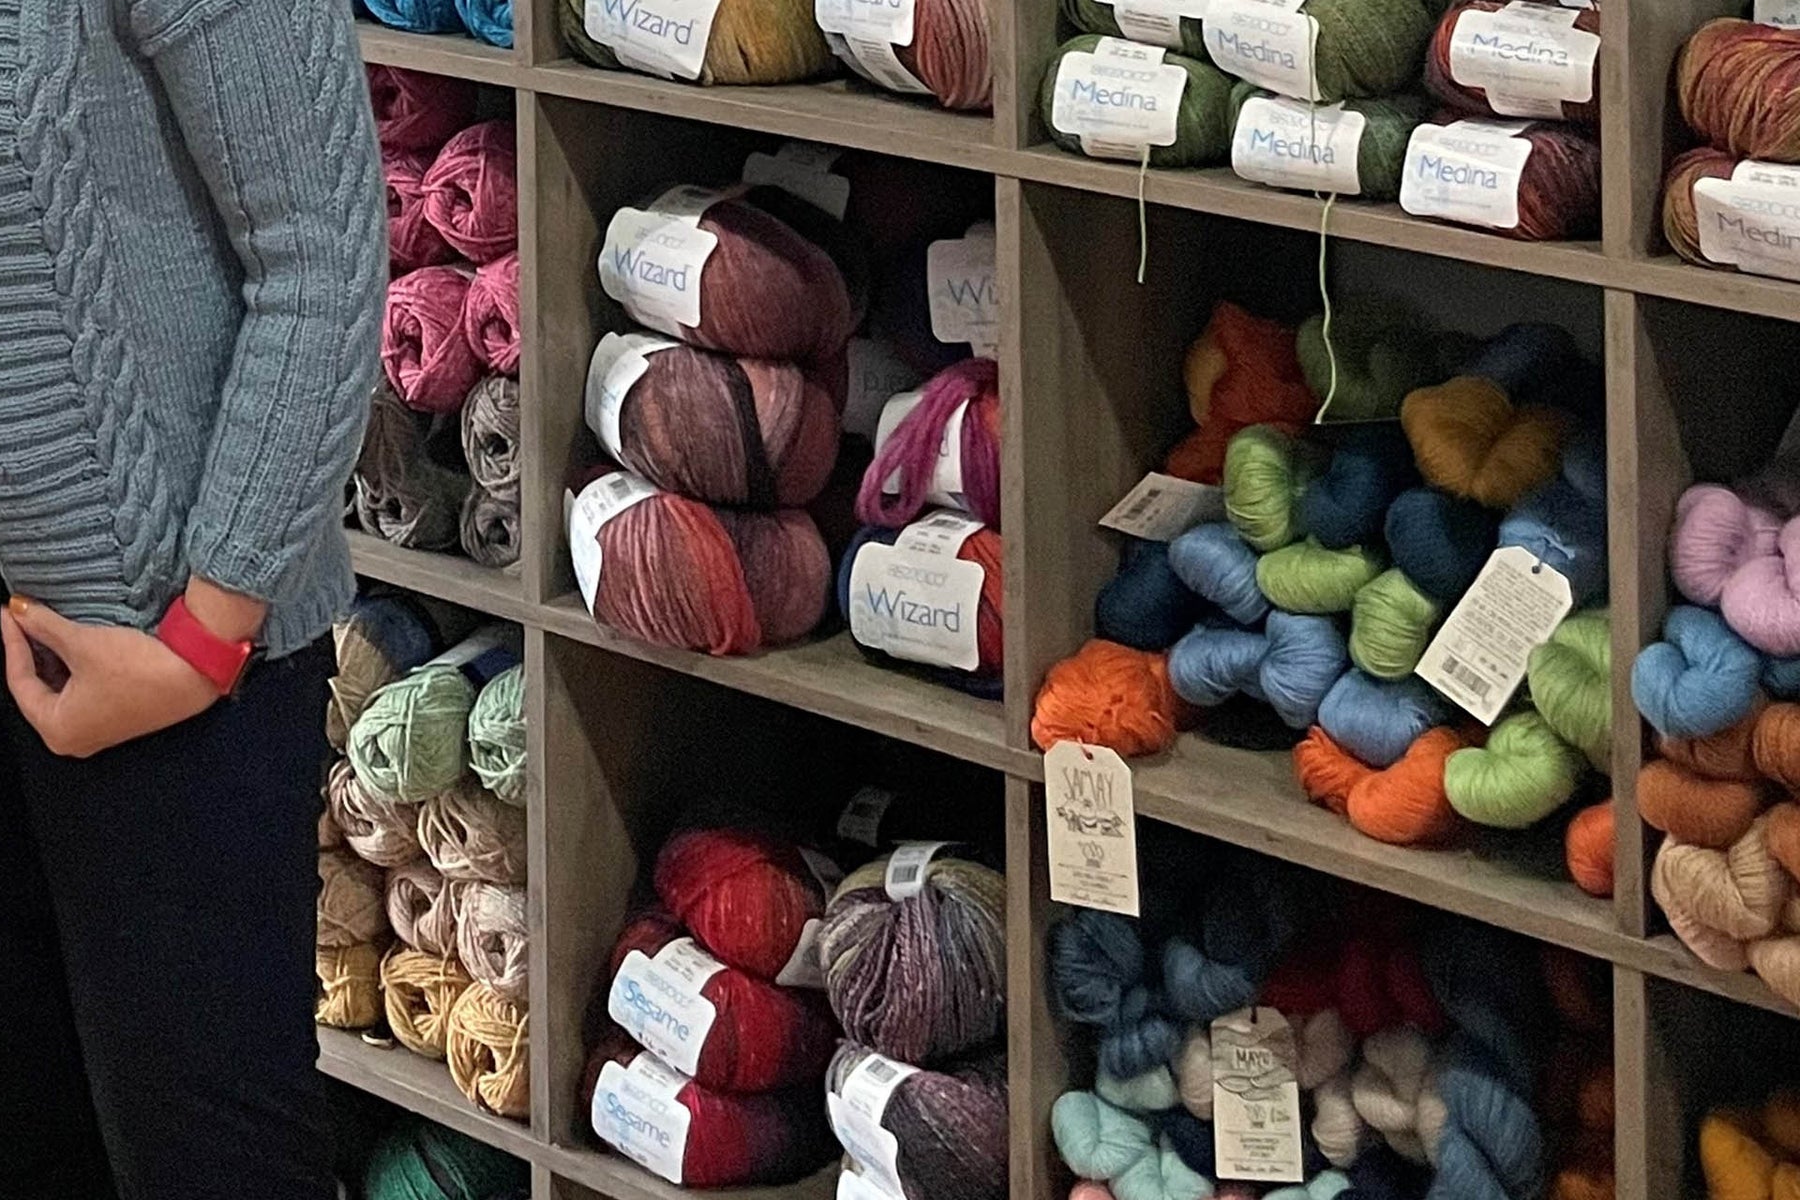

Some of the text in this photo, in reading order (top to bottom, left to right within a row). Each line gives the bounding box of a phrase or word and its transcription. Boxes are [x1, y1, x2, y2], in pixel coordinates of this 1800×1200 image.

[1217, 29, 1297, 70] Medina
[1471, 33, 1568, 67] Medina
[1072, 79, 1157, 112] Medina
[1250, 128, 1335, 164] Medina
[1419, 154, 1498, 189] Medina
[1716, 211, 1800, 250] Medin
[615, 243, 688, 291] Wizard
[866, 582, 960, 633] Wizard
[623, 979, 690, 1042] Sesame
[606, 1091, 671, 1148] Sesame
